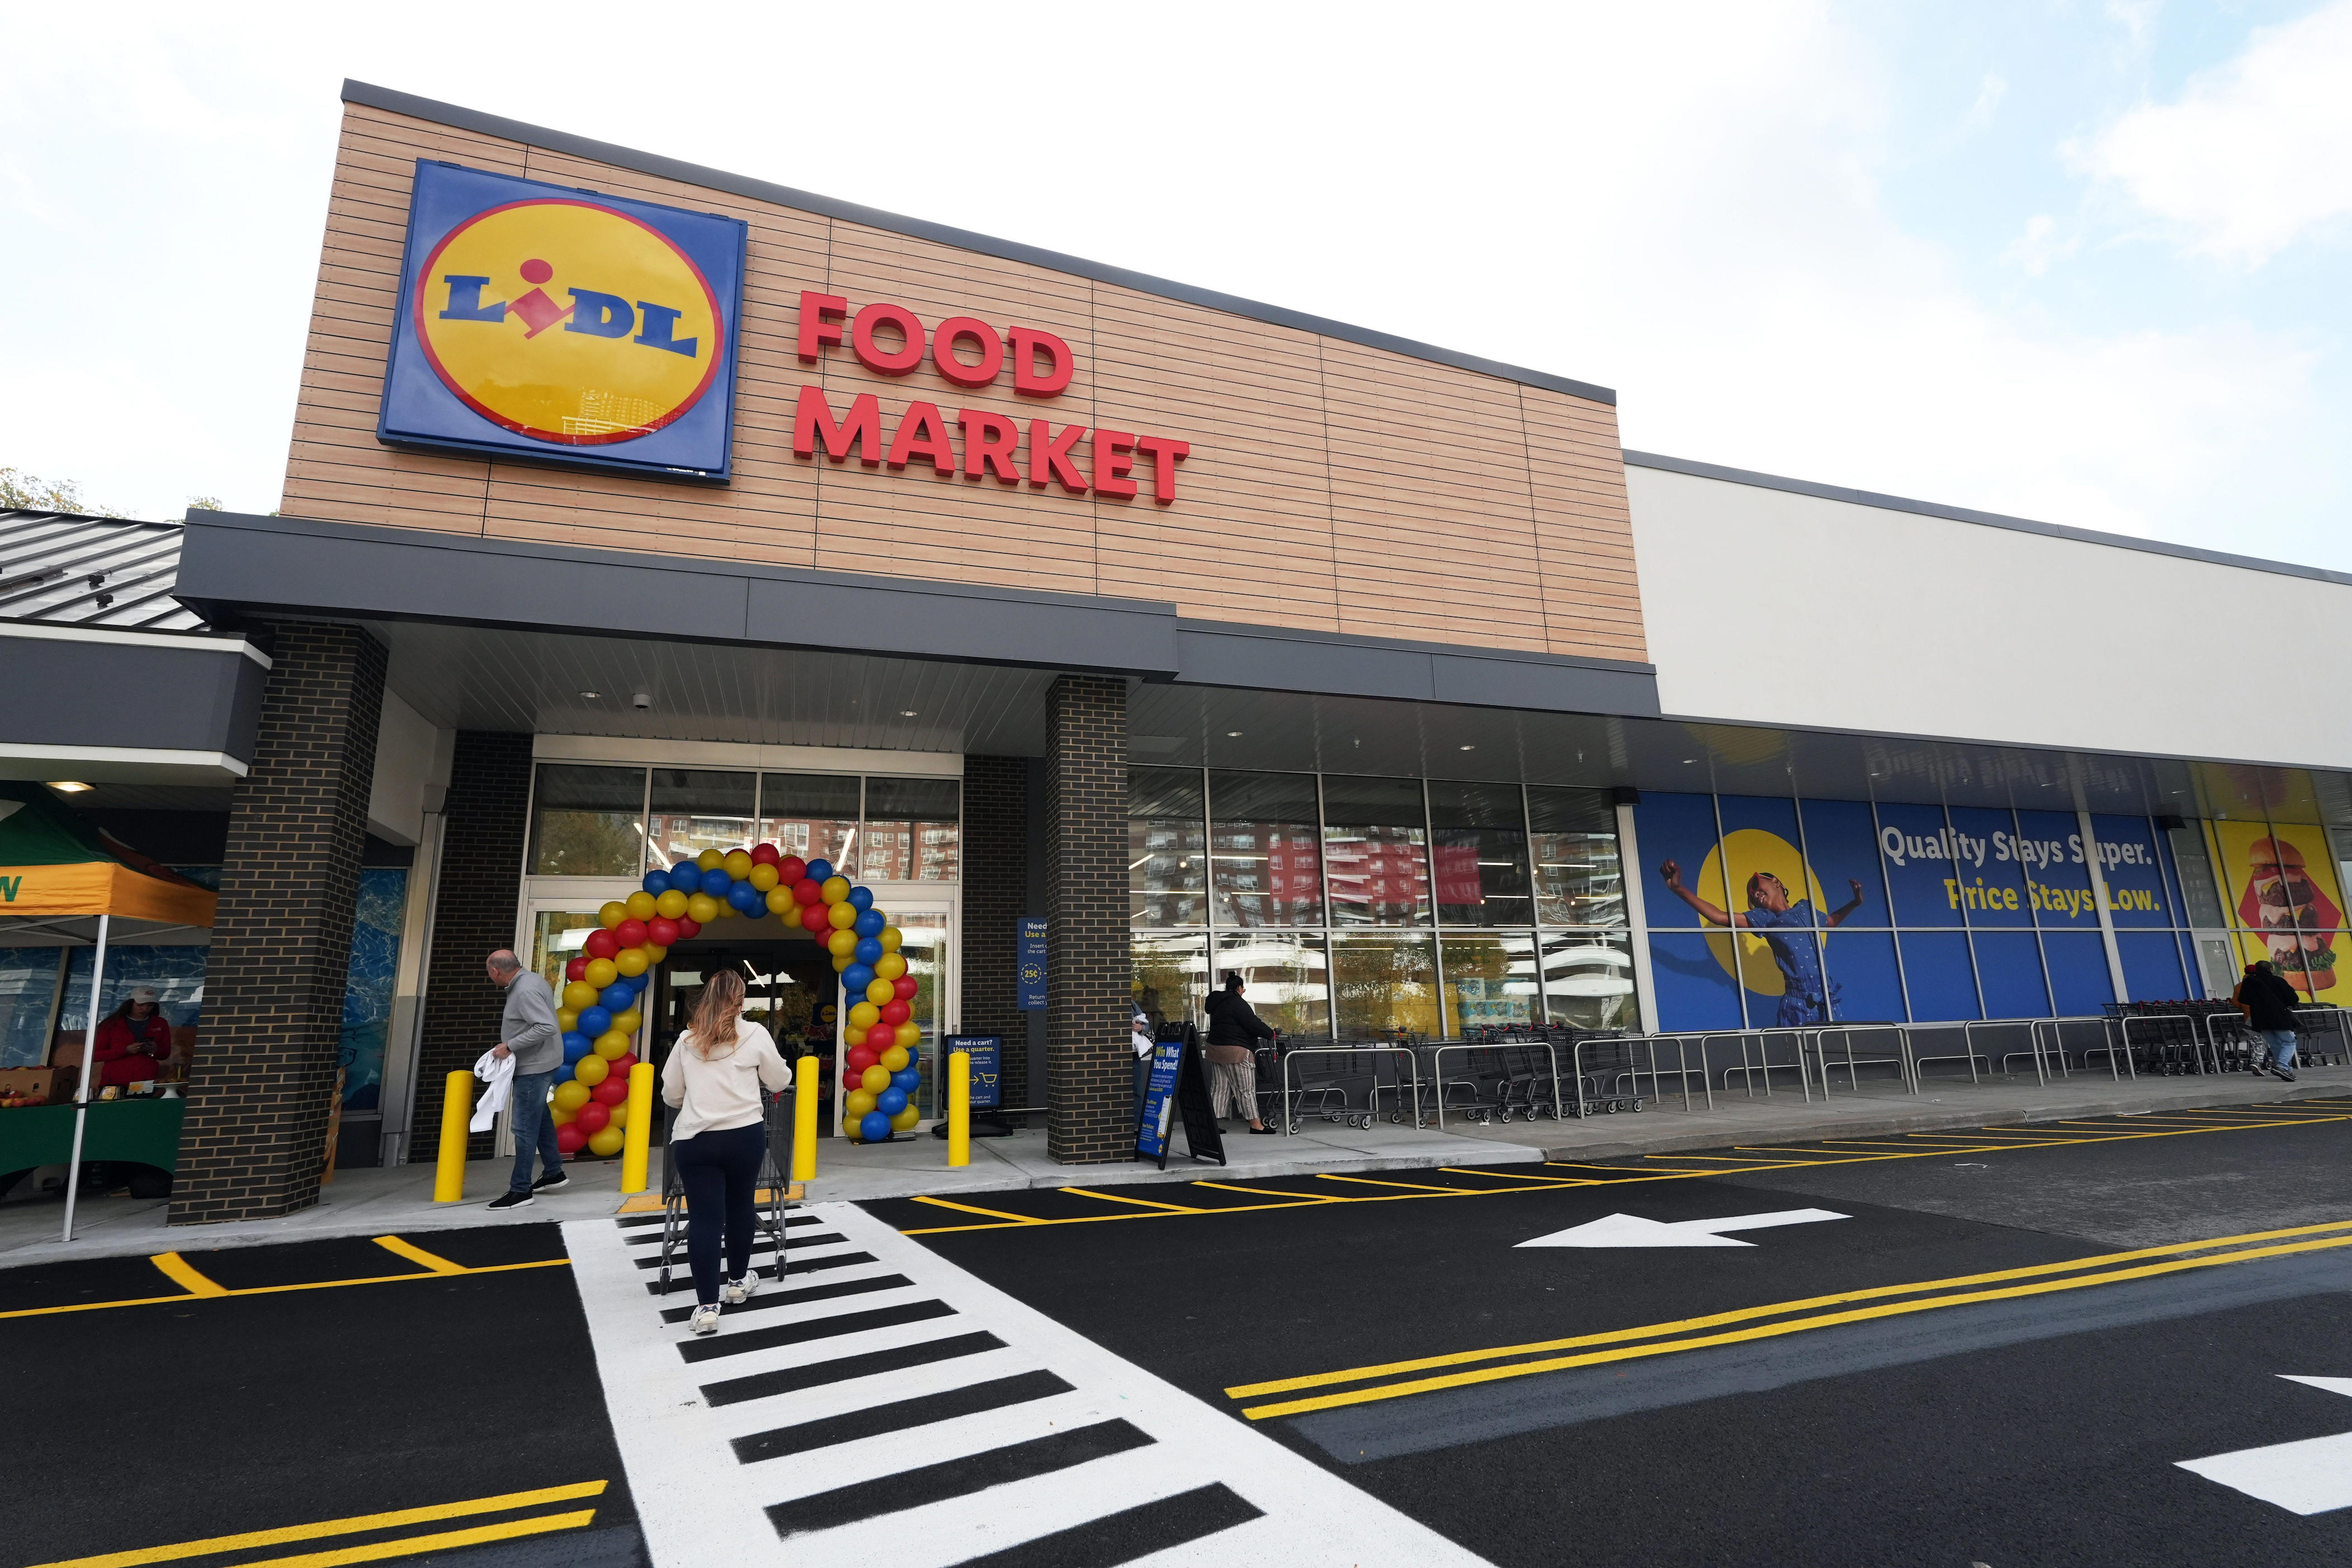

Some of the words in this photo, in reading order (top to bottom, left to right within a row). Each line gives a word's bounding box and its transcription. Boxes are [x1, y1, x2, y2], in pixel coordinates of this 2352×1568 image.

[798, 290, 1073, 398] FOOD
[794, 385, 1189, 506] MARKET
[1881, 826, 1985, 868] Quality
[1992, 831, 2064, 870] Stays
[2068, 834, 2152, 871] Super.
[1943, 877, 2019, 910] Price
[2024, 880, 2095, 918] Stays
[2103, 881, 2160, 911] Low.
[1154, 1059, 1162, 1069] You
[1161, 1059, 1178, 1072] Spend!
[1156, 1046, 1166, 1057] Win
[1166, 1046, 1179, 1058] What
